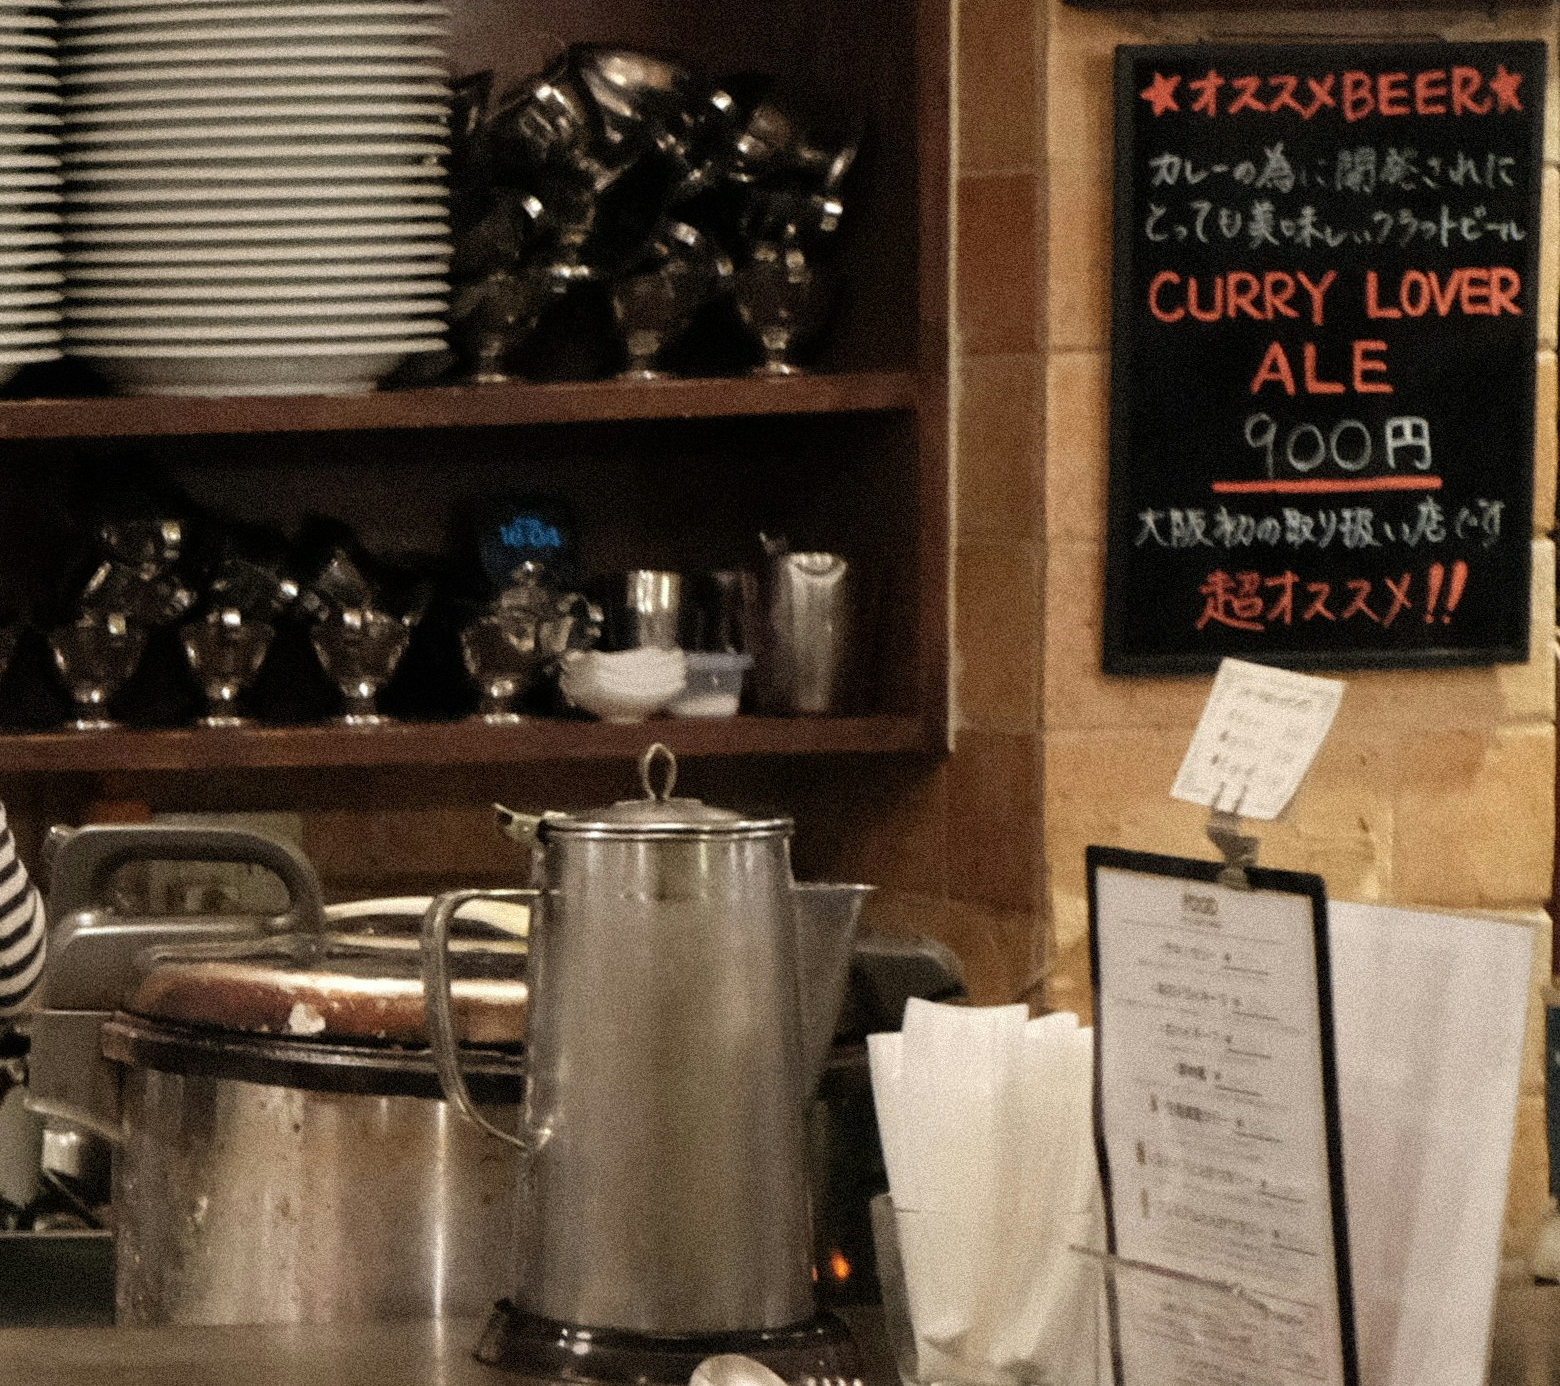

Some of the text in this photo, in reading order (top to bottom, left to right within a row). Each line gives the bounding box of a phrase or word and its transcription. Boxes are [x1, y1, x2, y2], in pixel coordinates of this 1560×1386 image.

[1149, 267, 1522, 324] CURRY LOVER
[1251, 340, 1393, 394] ALE
[1245, 414, 1432, 478] 900円
